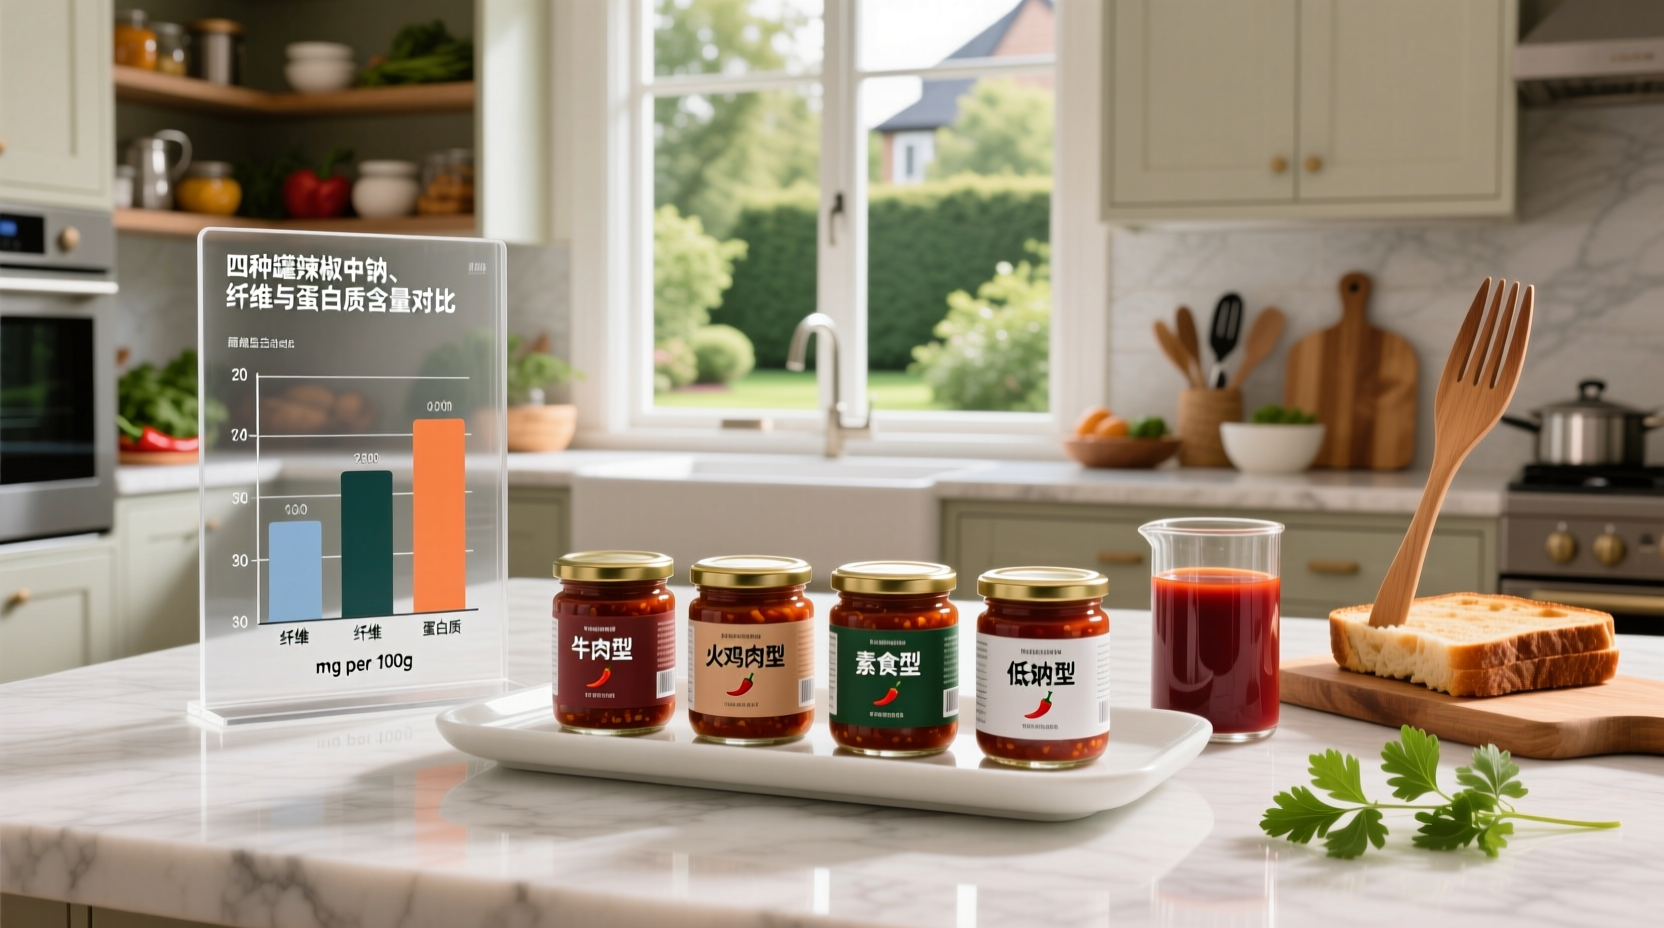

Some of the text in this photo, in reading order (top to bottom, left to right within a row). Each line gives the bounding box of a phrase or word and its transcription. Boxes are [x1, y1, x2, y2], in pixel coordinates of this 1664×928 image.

[226, 282, 456, 314] 纤维与蛋白质含量对比
[231, 368, 248, 382] 20
[232, 553, 249, 568] 30
[232, 615, 248, 629] 30
[423, 618, 462, 637] 蛋白质
[571, 635, 633, 661] 牛肉型
[705, 643, 786, 669] 火鸡肉型
[316, 653, 413, 678] mg per 100g
[855, 650, 921, 677] 素食型
